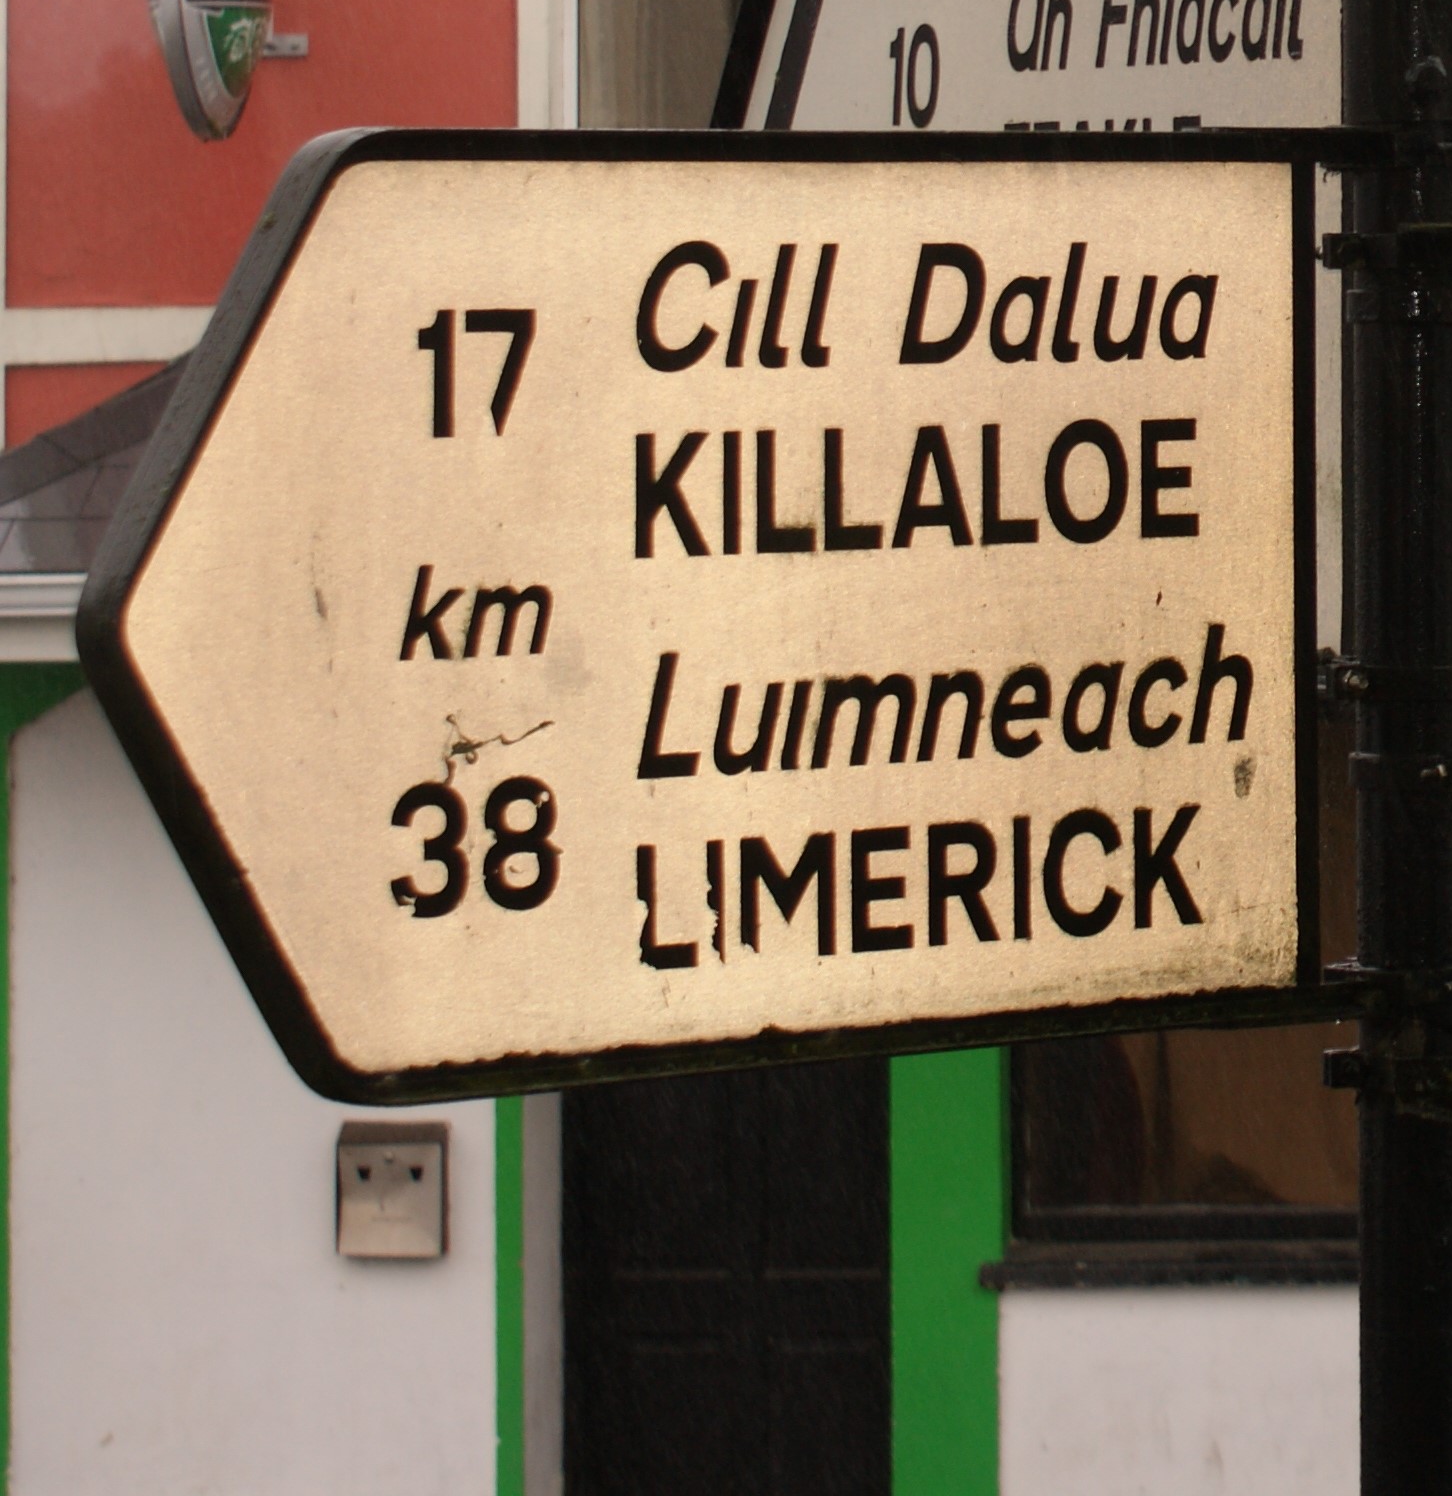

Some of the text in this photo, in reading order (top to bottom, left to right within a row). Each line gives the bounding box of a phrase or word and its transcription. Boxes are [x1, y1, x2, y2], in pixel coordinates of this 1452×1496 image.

[889, 23, 941, 129] 10
[416, 239, 1219, 439] 17 Cill Dalua
[633, 417, 1201, 559] KILLALOE
[399, 565, 553, 662] km
[637, 623, 1255, 782] Luimneach
[388, 774, 1205, 970] 38 LIMERICK
